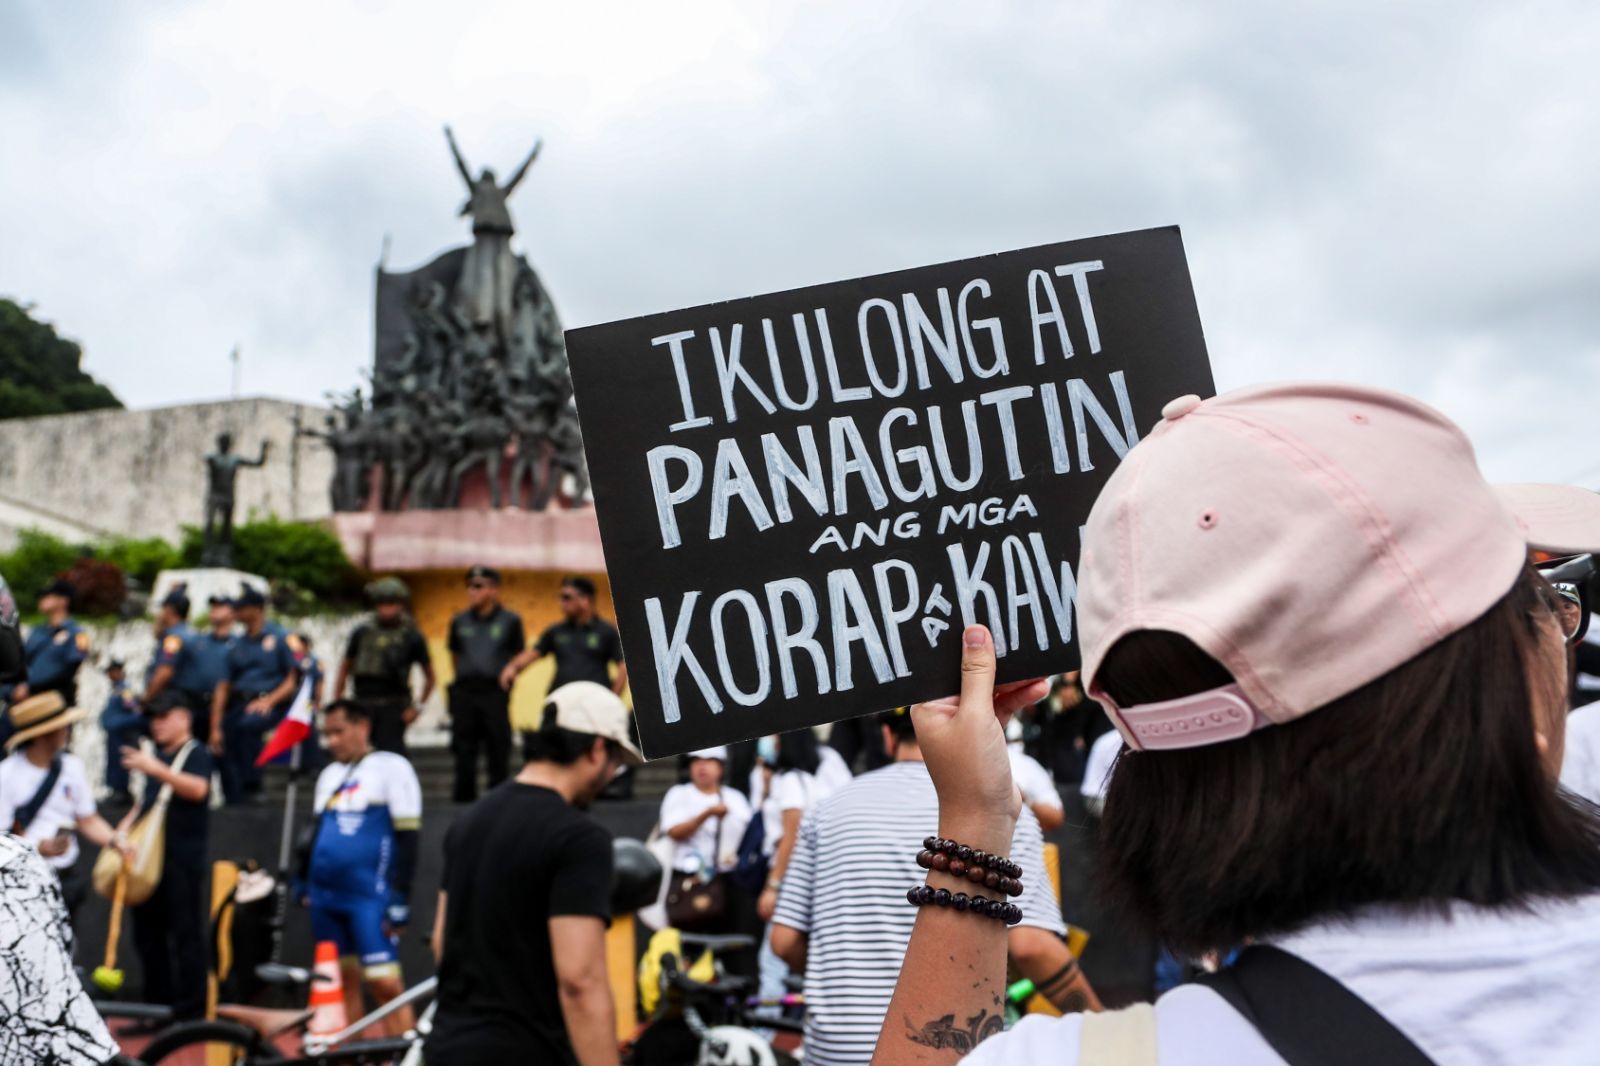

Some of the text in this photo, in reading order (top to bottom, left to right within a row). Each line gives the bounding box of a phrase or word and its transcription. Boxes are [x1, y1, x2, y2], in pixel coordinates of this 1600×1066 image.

[650, 259, 1105, 433] IKULONG AT
[646, 369, 1140, 550] PANAGUTIN
[808, 494, 1038, 554] ANG MGA
[643, 558, 920, 724] KORAP
[921, 582, 953, 648] AT
